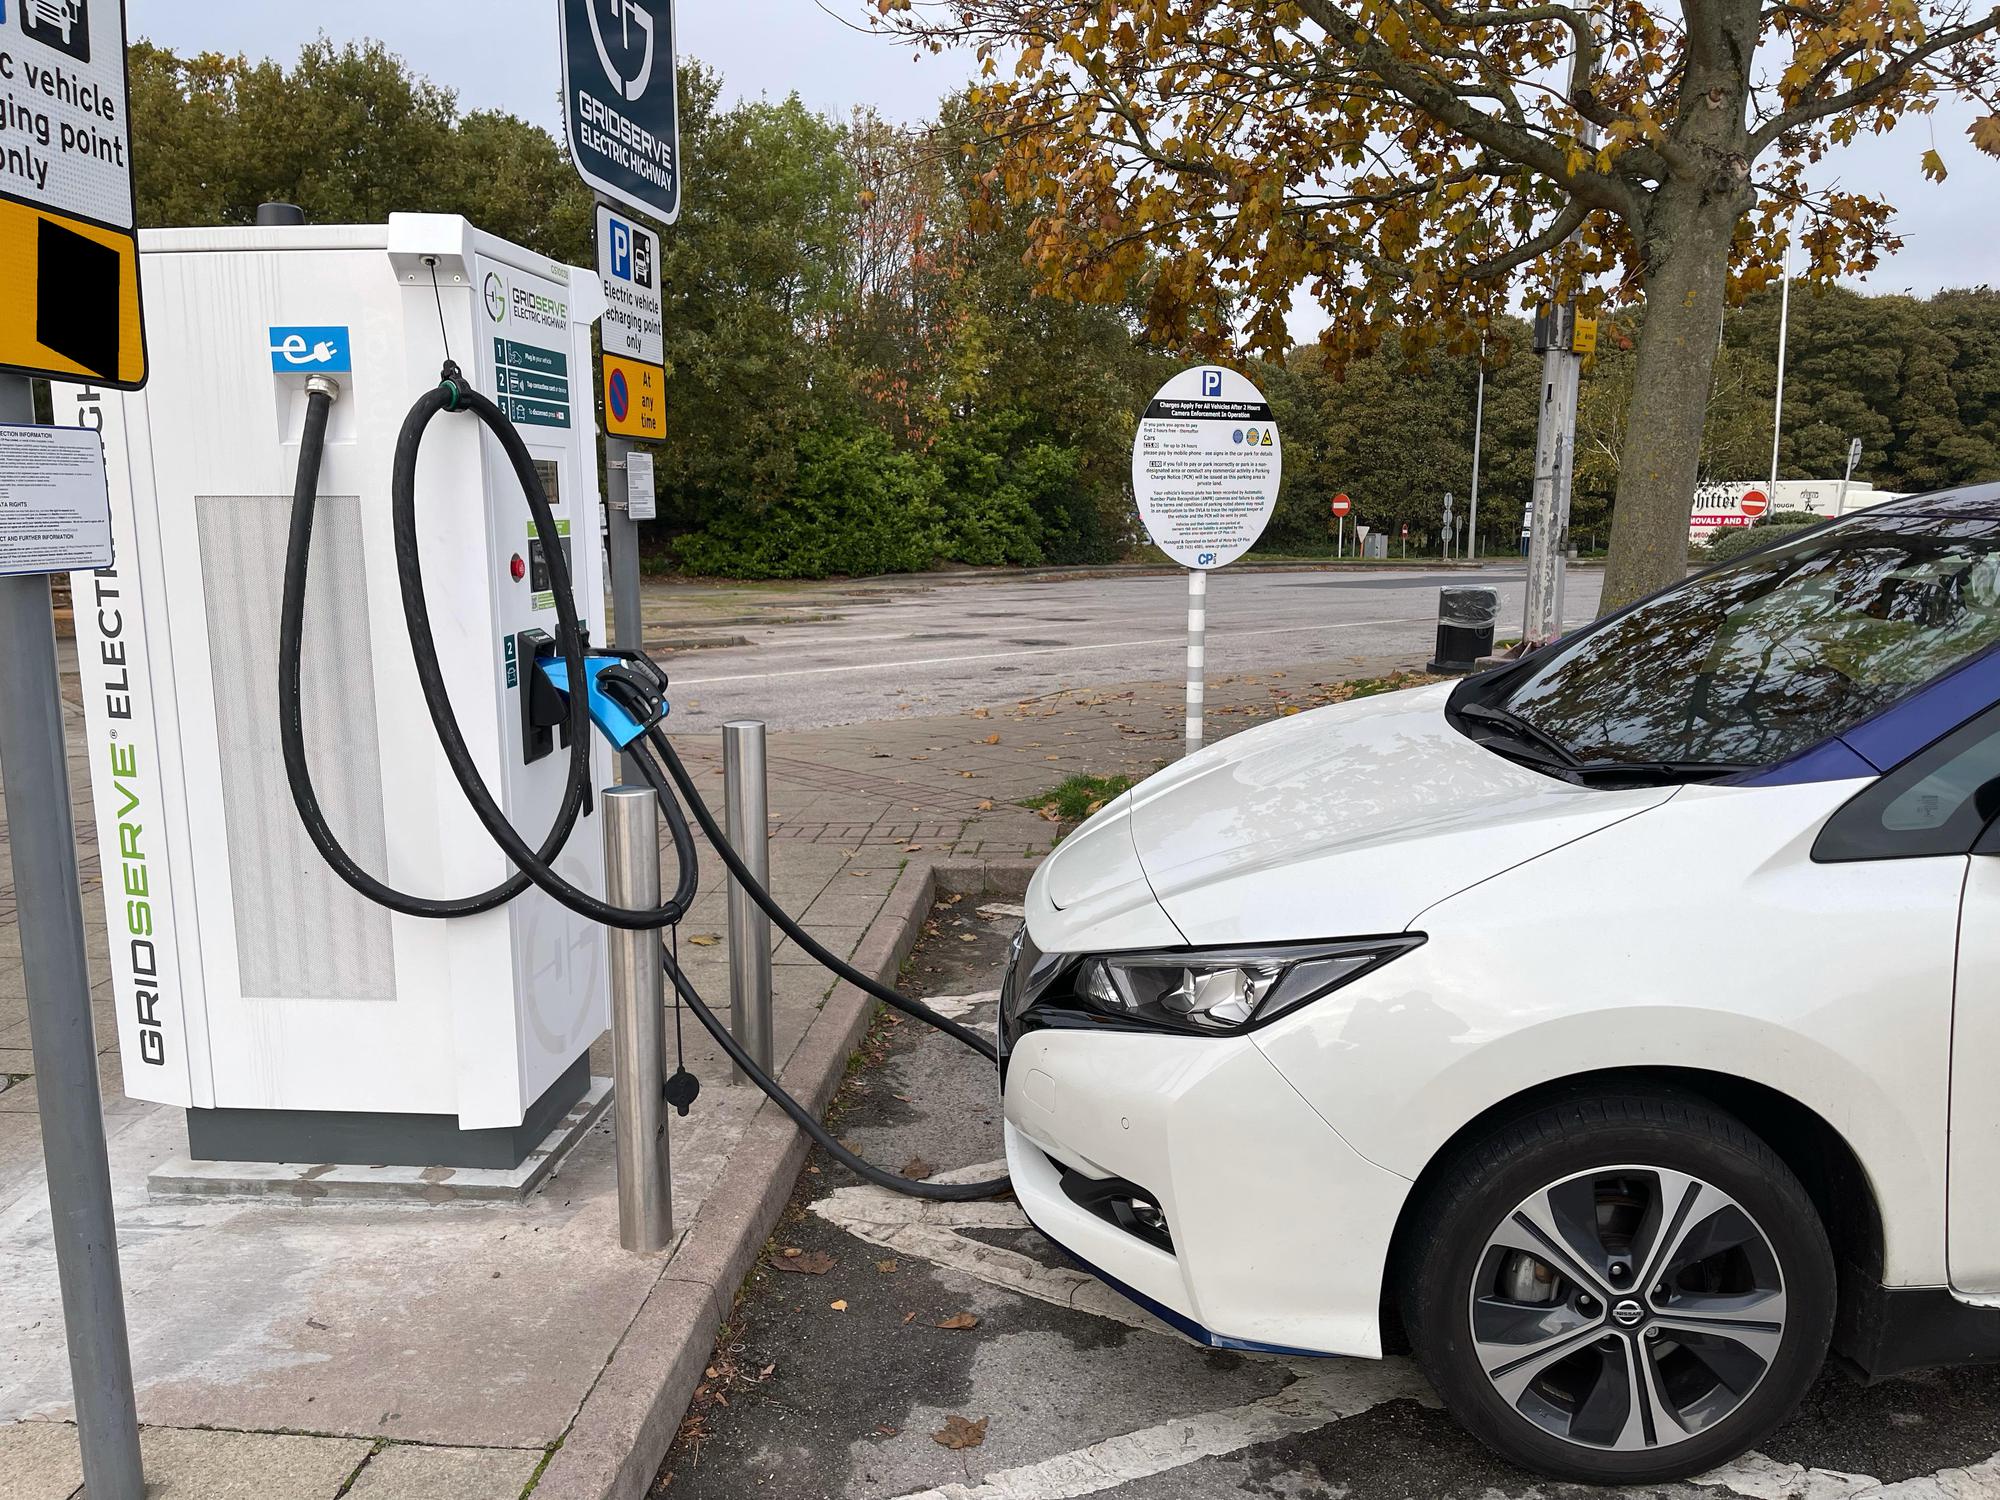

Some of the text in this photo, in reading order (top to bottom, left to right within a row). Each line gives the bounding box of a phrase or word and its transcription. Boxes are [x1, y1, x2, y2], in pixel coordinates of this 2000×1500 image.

[24, 62, 114, 121] vehicle
[579, 90, 672, 170] GRIDSERVE
[60, 122, 124, 167] point
[580, 122, 672, 192] ELECTRIC HIGHWAY
[614, 227, 628, 272] P
[604, 280, 658, 314] Electric vehicle
[514, 306, 566, 330] ELECTRIC HIGHWAY
[644, 321, 661, 336] point
[498, 345, 501, 357] 1
[627, 335, 641, 352] only
[499, 374, 504, 386] 2
[643, 372, 651, 388] At
[1205, 372, 1218, 396] P
[501, 402, 506, 414] 3
[642, 396, 653, 412] any
[641, 416, 656, 429] time
[1694, 492, 1738, 511] hifter
[1198, 554, 1213, 564] CP
[507, 642, 513, 655] 2
